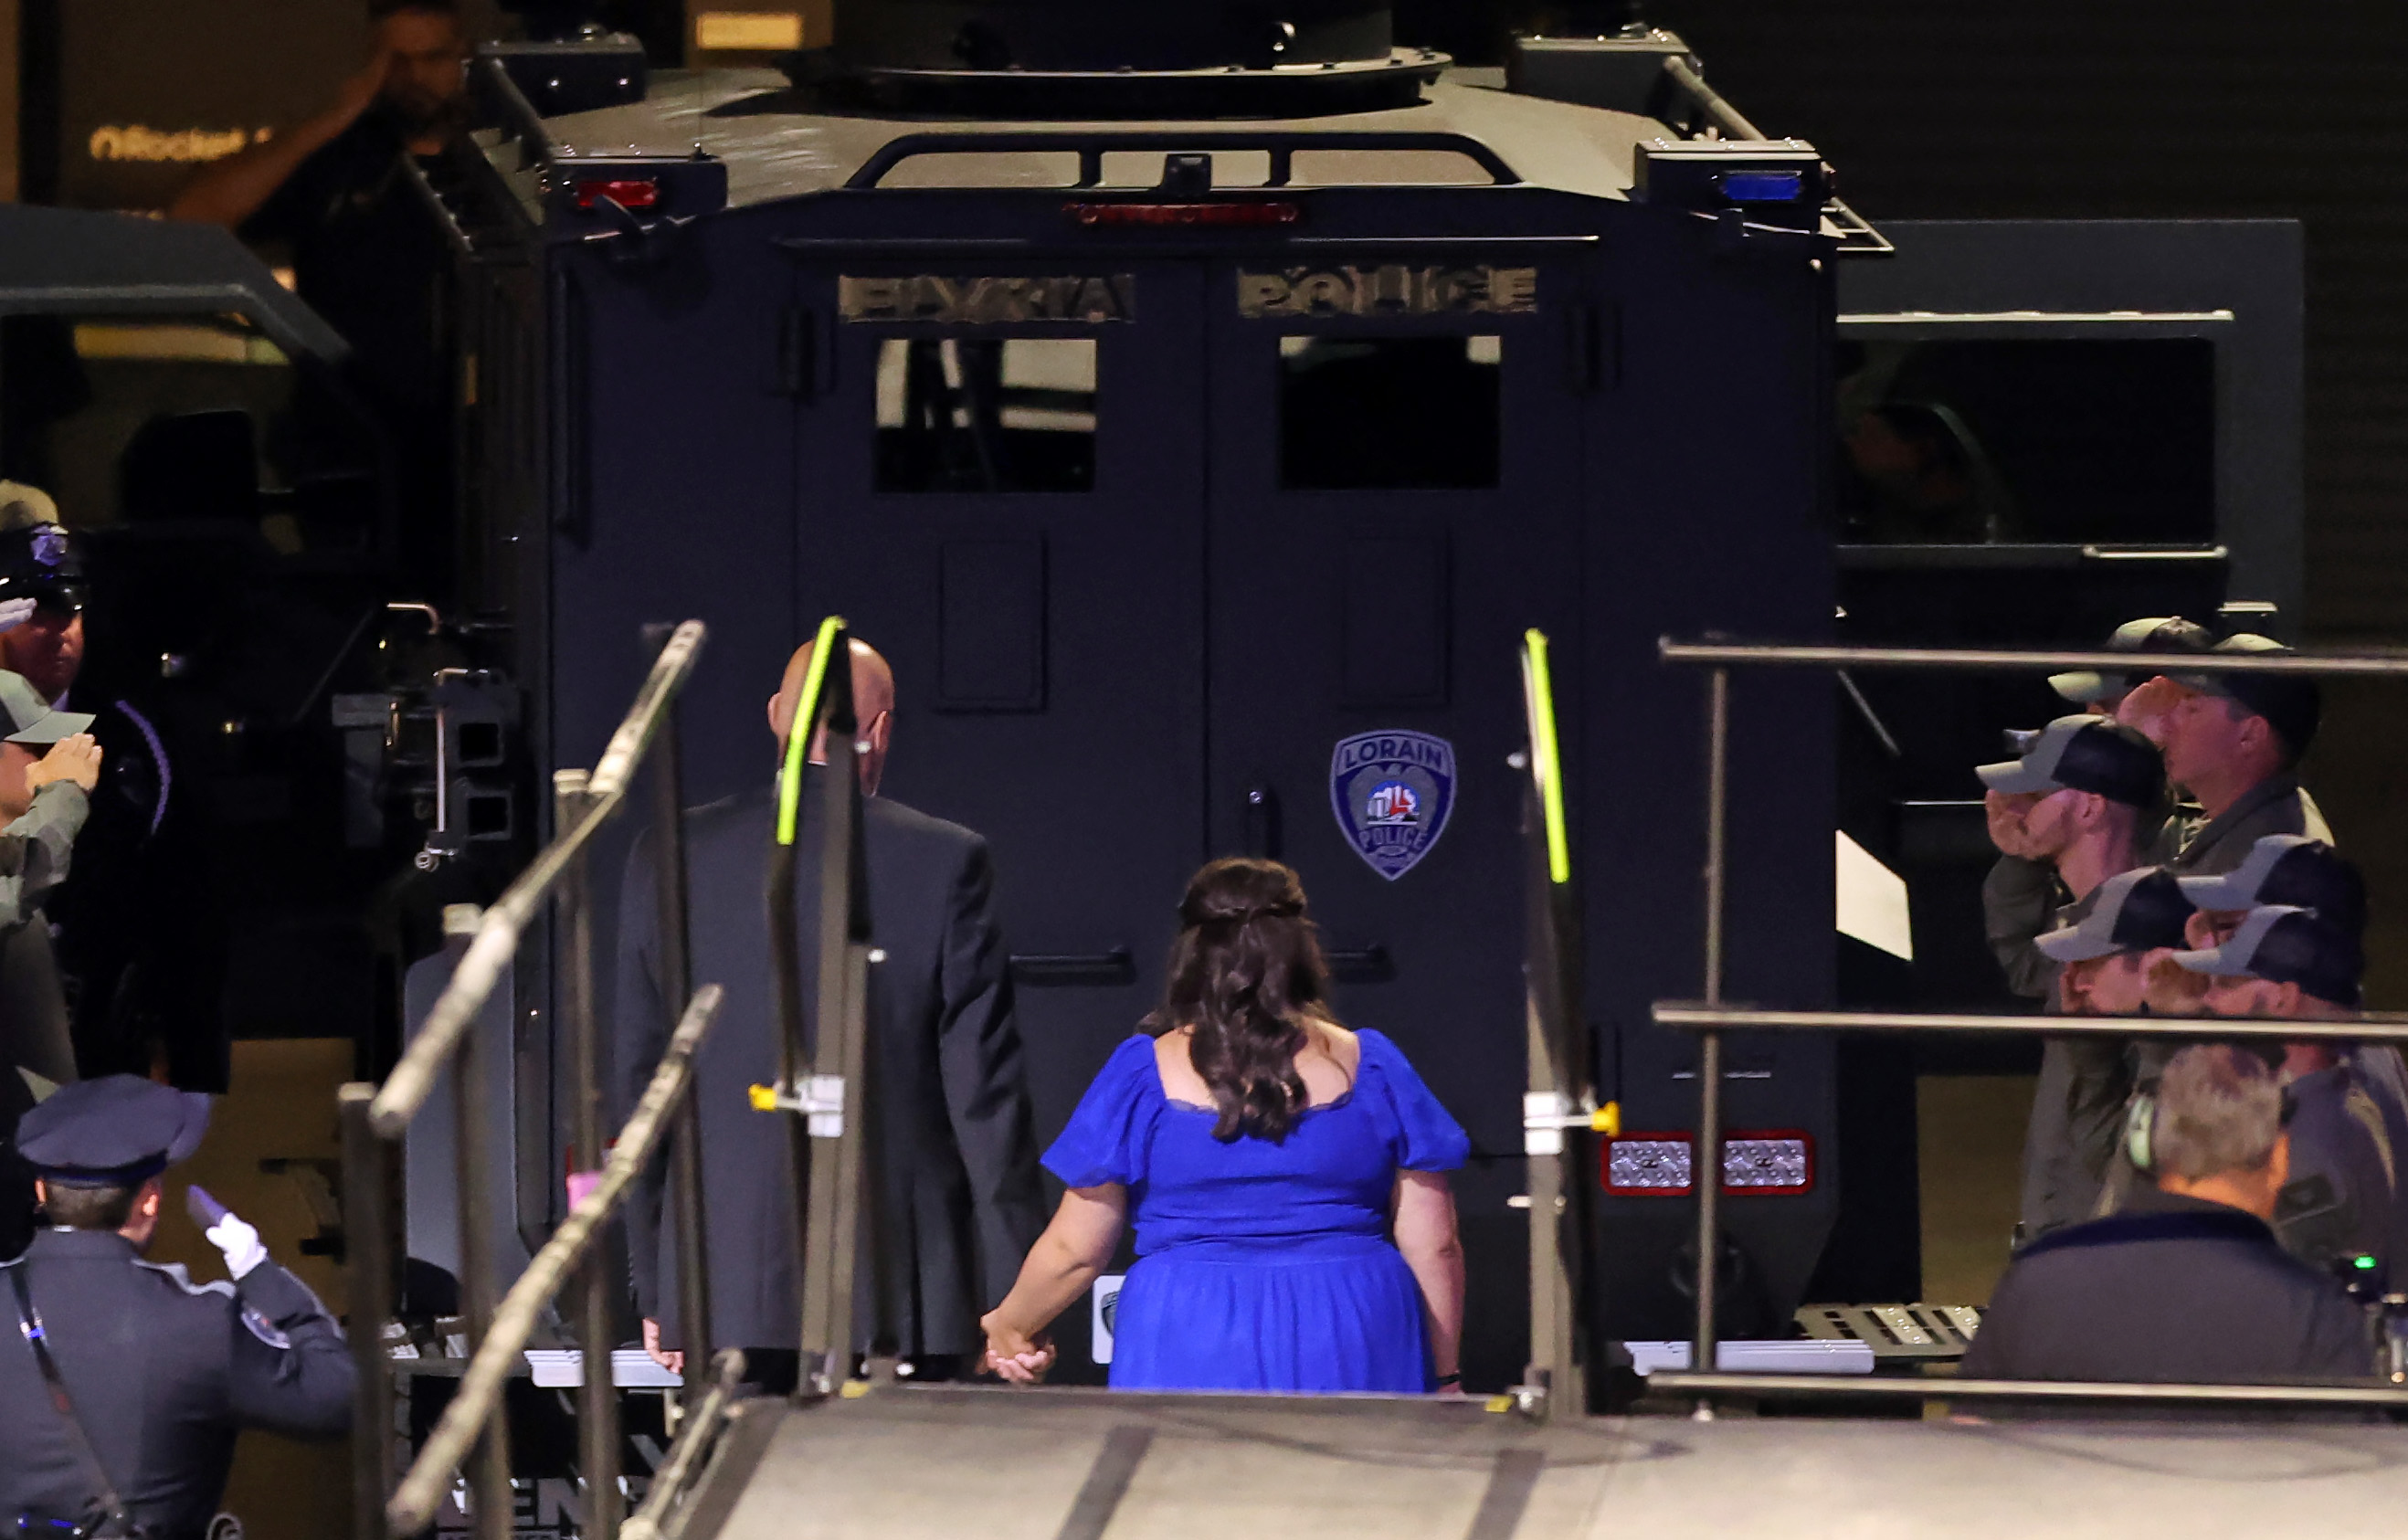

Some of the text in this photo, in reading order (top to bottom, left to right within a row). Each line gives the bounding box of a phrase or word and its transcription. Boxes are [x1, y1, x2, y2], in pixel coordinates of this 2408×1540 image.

[1237, 266, 1537, 317] POLICE
[1346, 738, 1442, 769] LORAIN
[1358, 825, 1429, 852] POLICE
